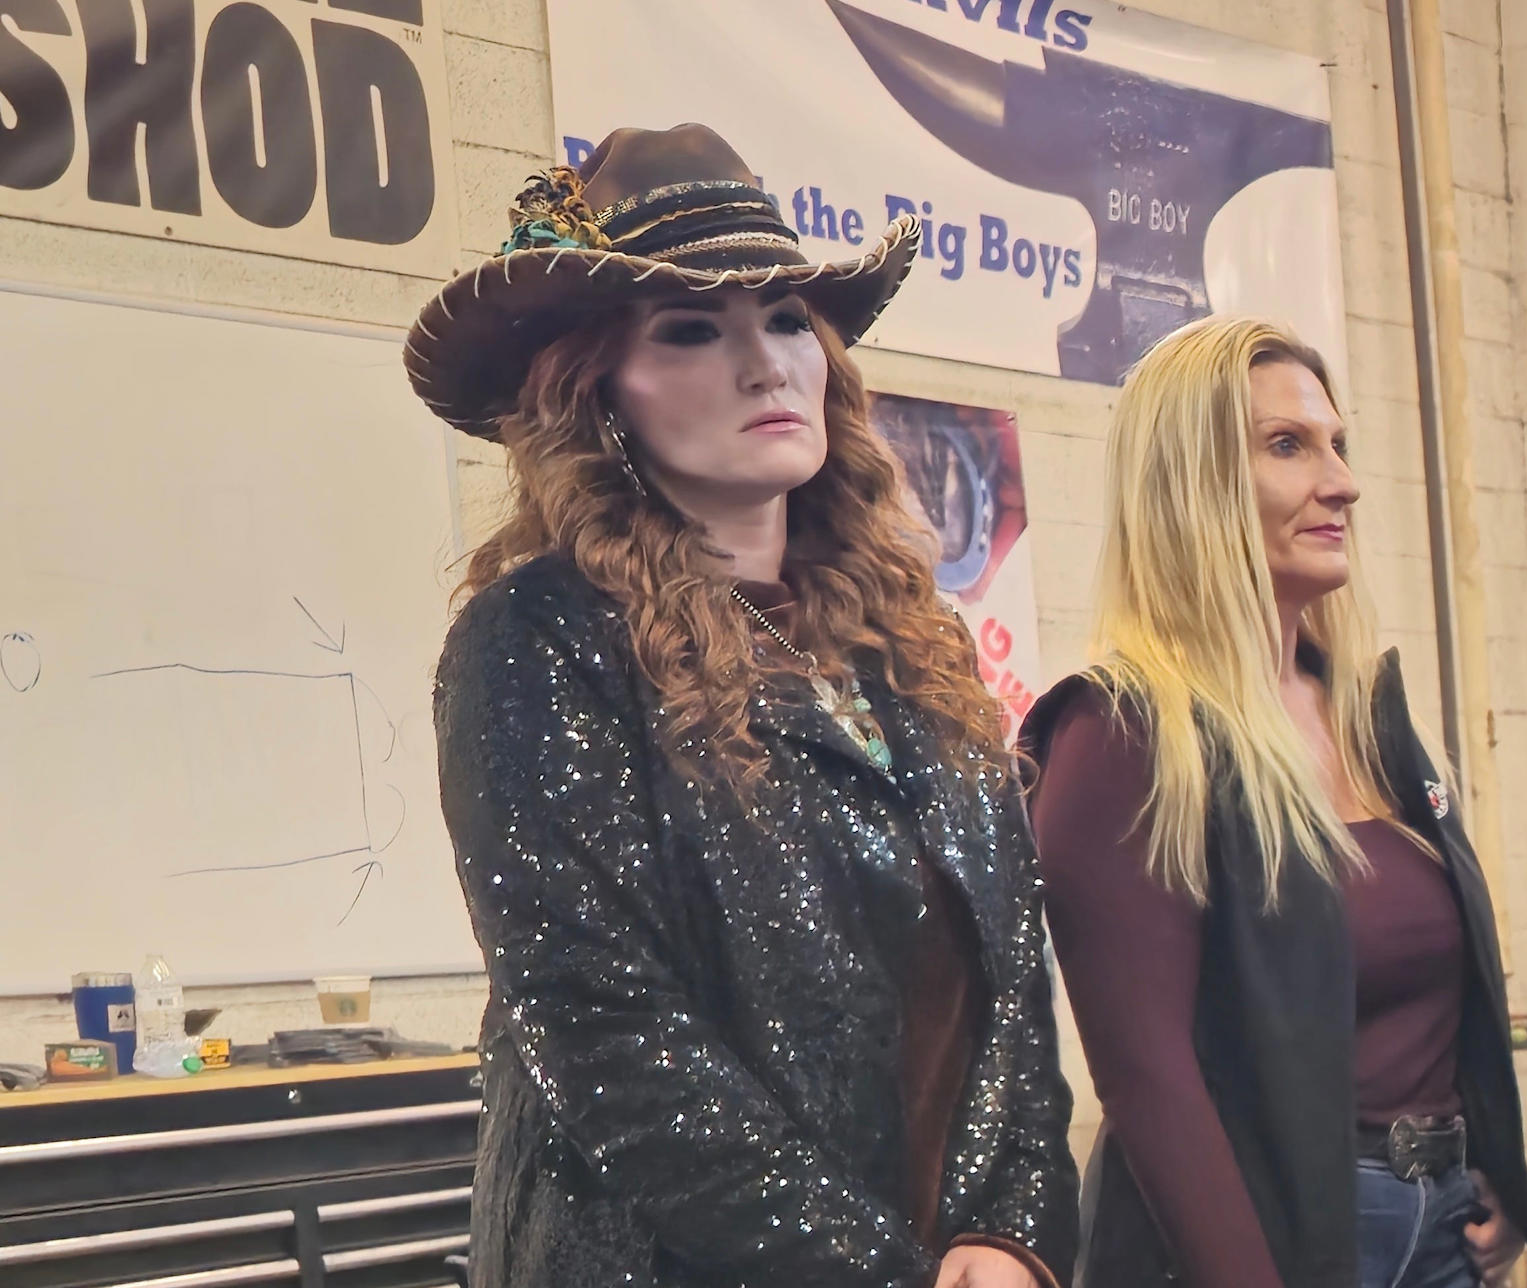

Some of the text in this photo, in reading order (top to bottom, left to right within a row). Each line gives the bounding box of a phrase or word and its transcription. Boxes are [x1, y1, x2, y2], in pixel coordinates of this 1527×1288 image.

[792, 186, 864, 245] the
[979, 213, 1082, 299] Boys
[1149, 198, 1191, 235] BOY
